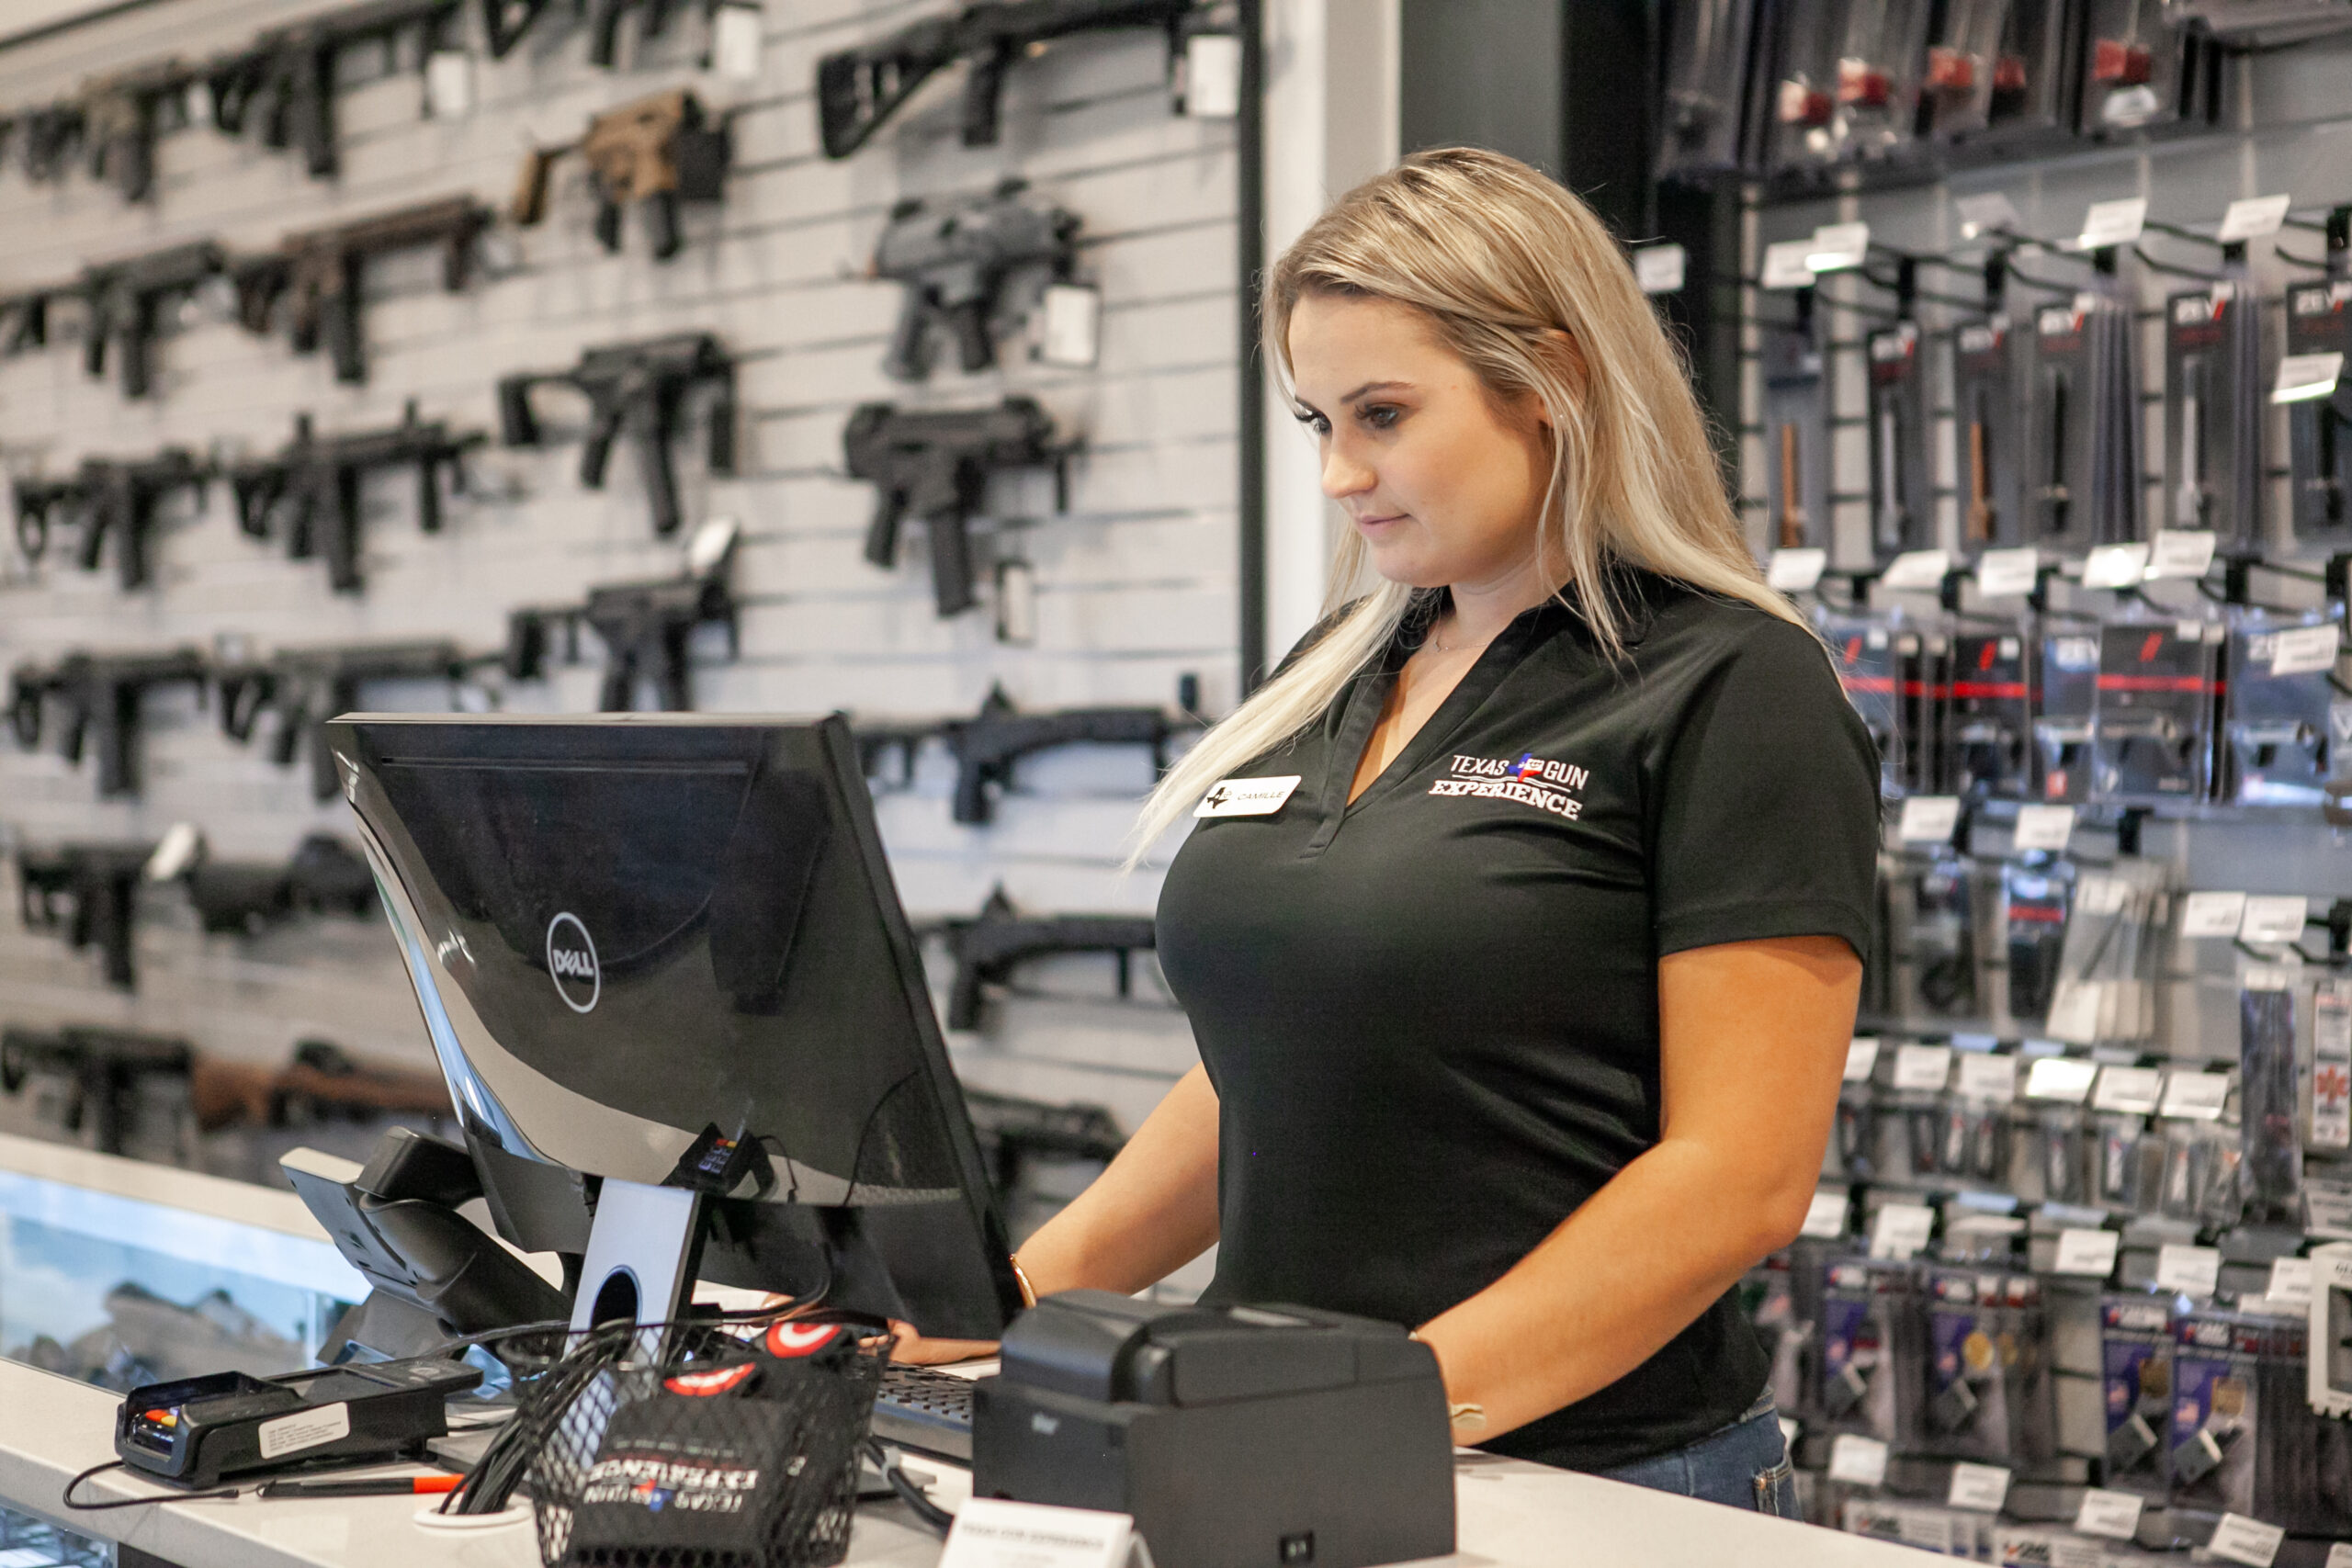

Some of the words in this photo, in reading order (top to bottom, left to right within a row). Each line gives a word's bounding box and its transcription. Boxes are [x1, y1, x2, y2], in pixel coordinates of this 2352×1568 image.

[1450, 754, 1510, 776] TEXAS
[1543, 760, 1589, 791] GUN
[1238, 791, 1285, 801] CAMILLE
[1428, 779, 1583, 821] EXPERIENCE
[552, 949, 595, 976] DELL
